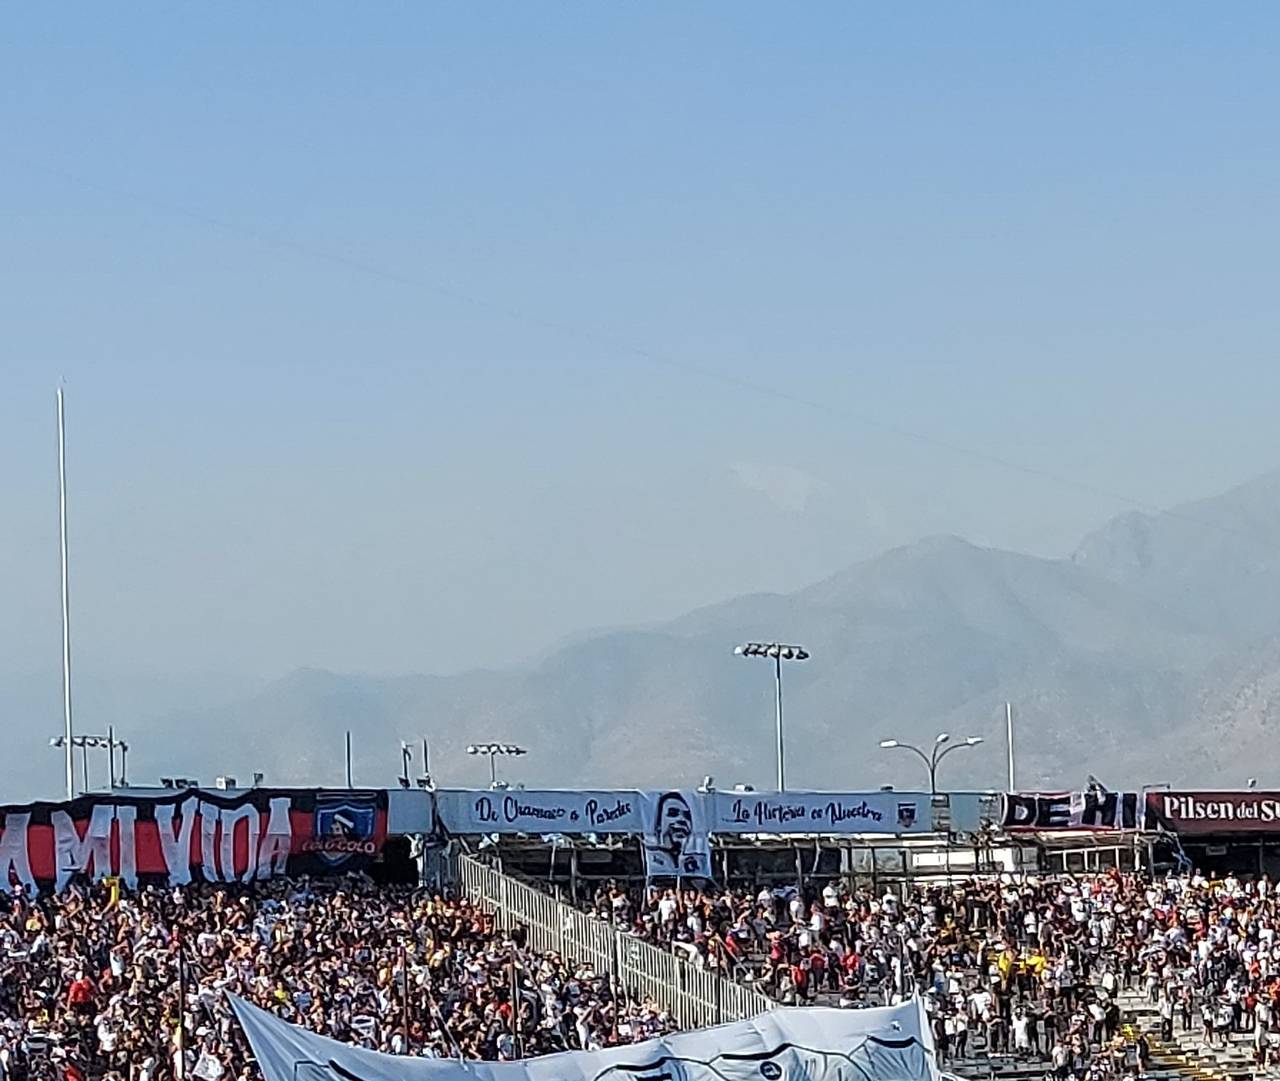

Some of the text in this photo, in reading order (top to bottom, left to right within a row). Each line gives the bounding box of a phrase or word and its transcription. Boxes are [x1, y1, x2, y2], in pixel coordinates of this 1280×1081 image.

[1164, 796, 1234, 821] Pilsen
[1236, 804, 1258, 820] del
[51, 803, 138, 894] MI
[154, 796, 292, 887] VIDA
